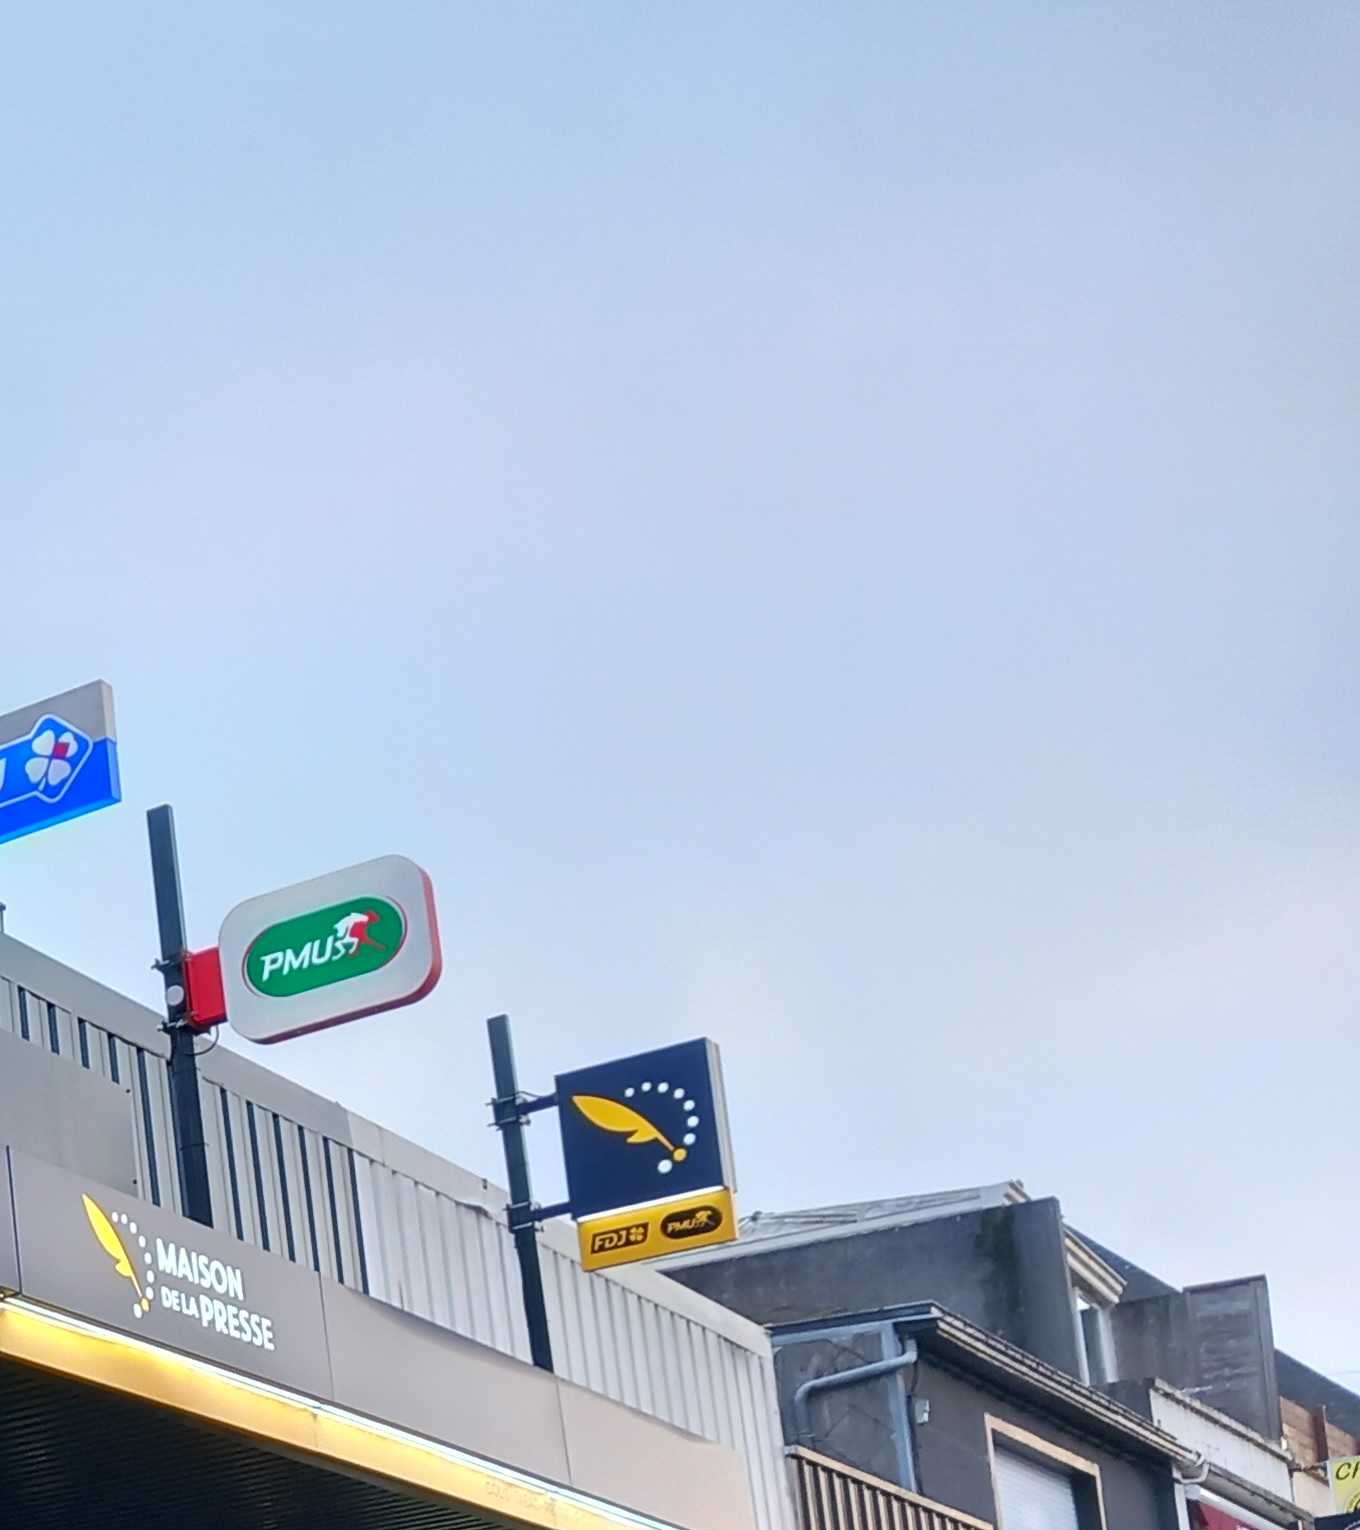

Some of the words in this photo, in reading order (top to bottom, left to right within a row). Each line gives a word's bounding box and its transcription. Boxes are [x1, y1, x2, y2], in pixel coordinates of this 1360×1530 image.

[260, 935, 333, 983] PMU
[594, 1230, 627, 1251] FDJ
[667, 1217, 696, 1234] PMU
[156, 1238, 244, 1301] MAISON
[161, 1286, 180, 1311] DE
[181, 1293, 199, 1318] LA
[199, 1294, 275, 1351] PRESSE
